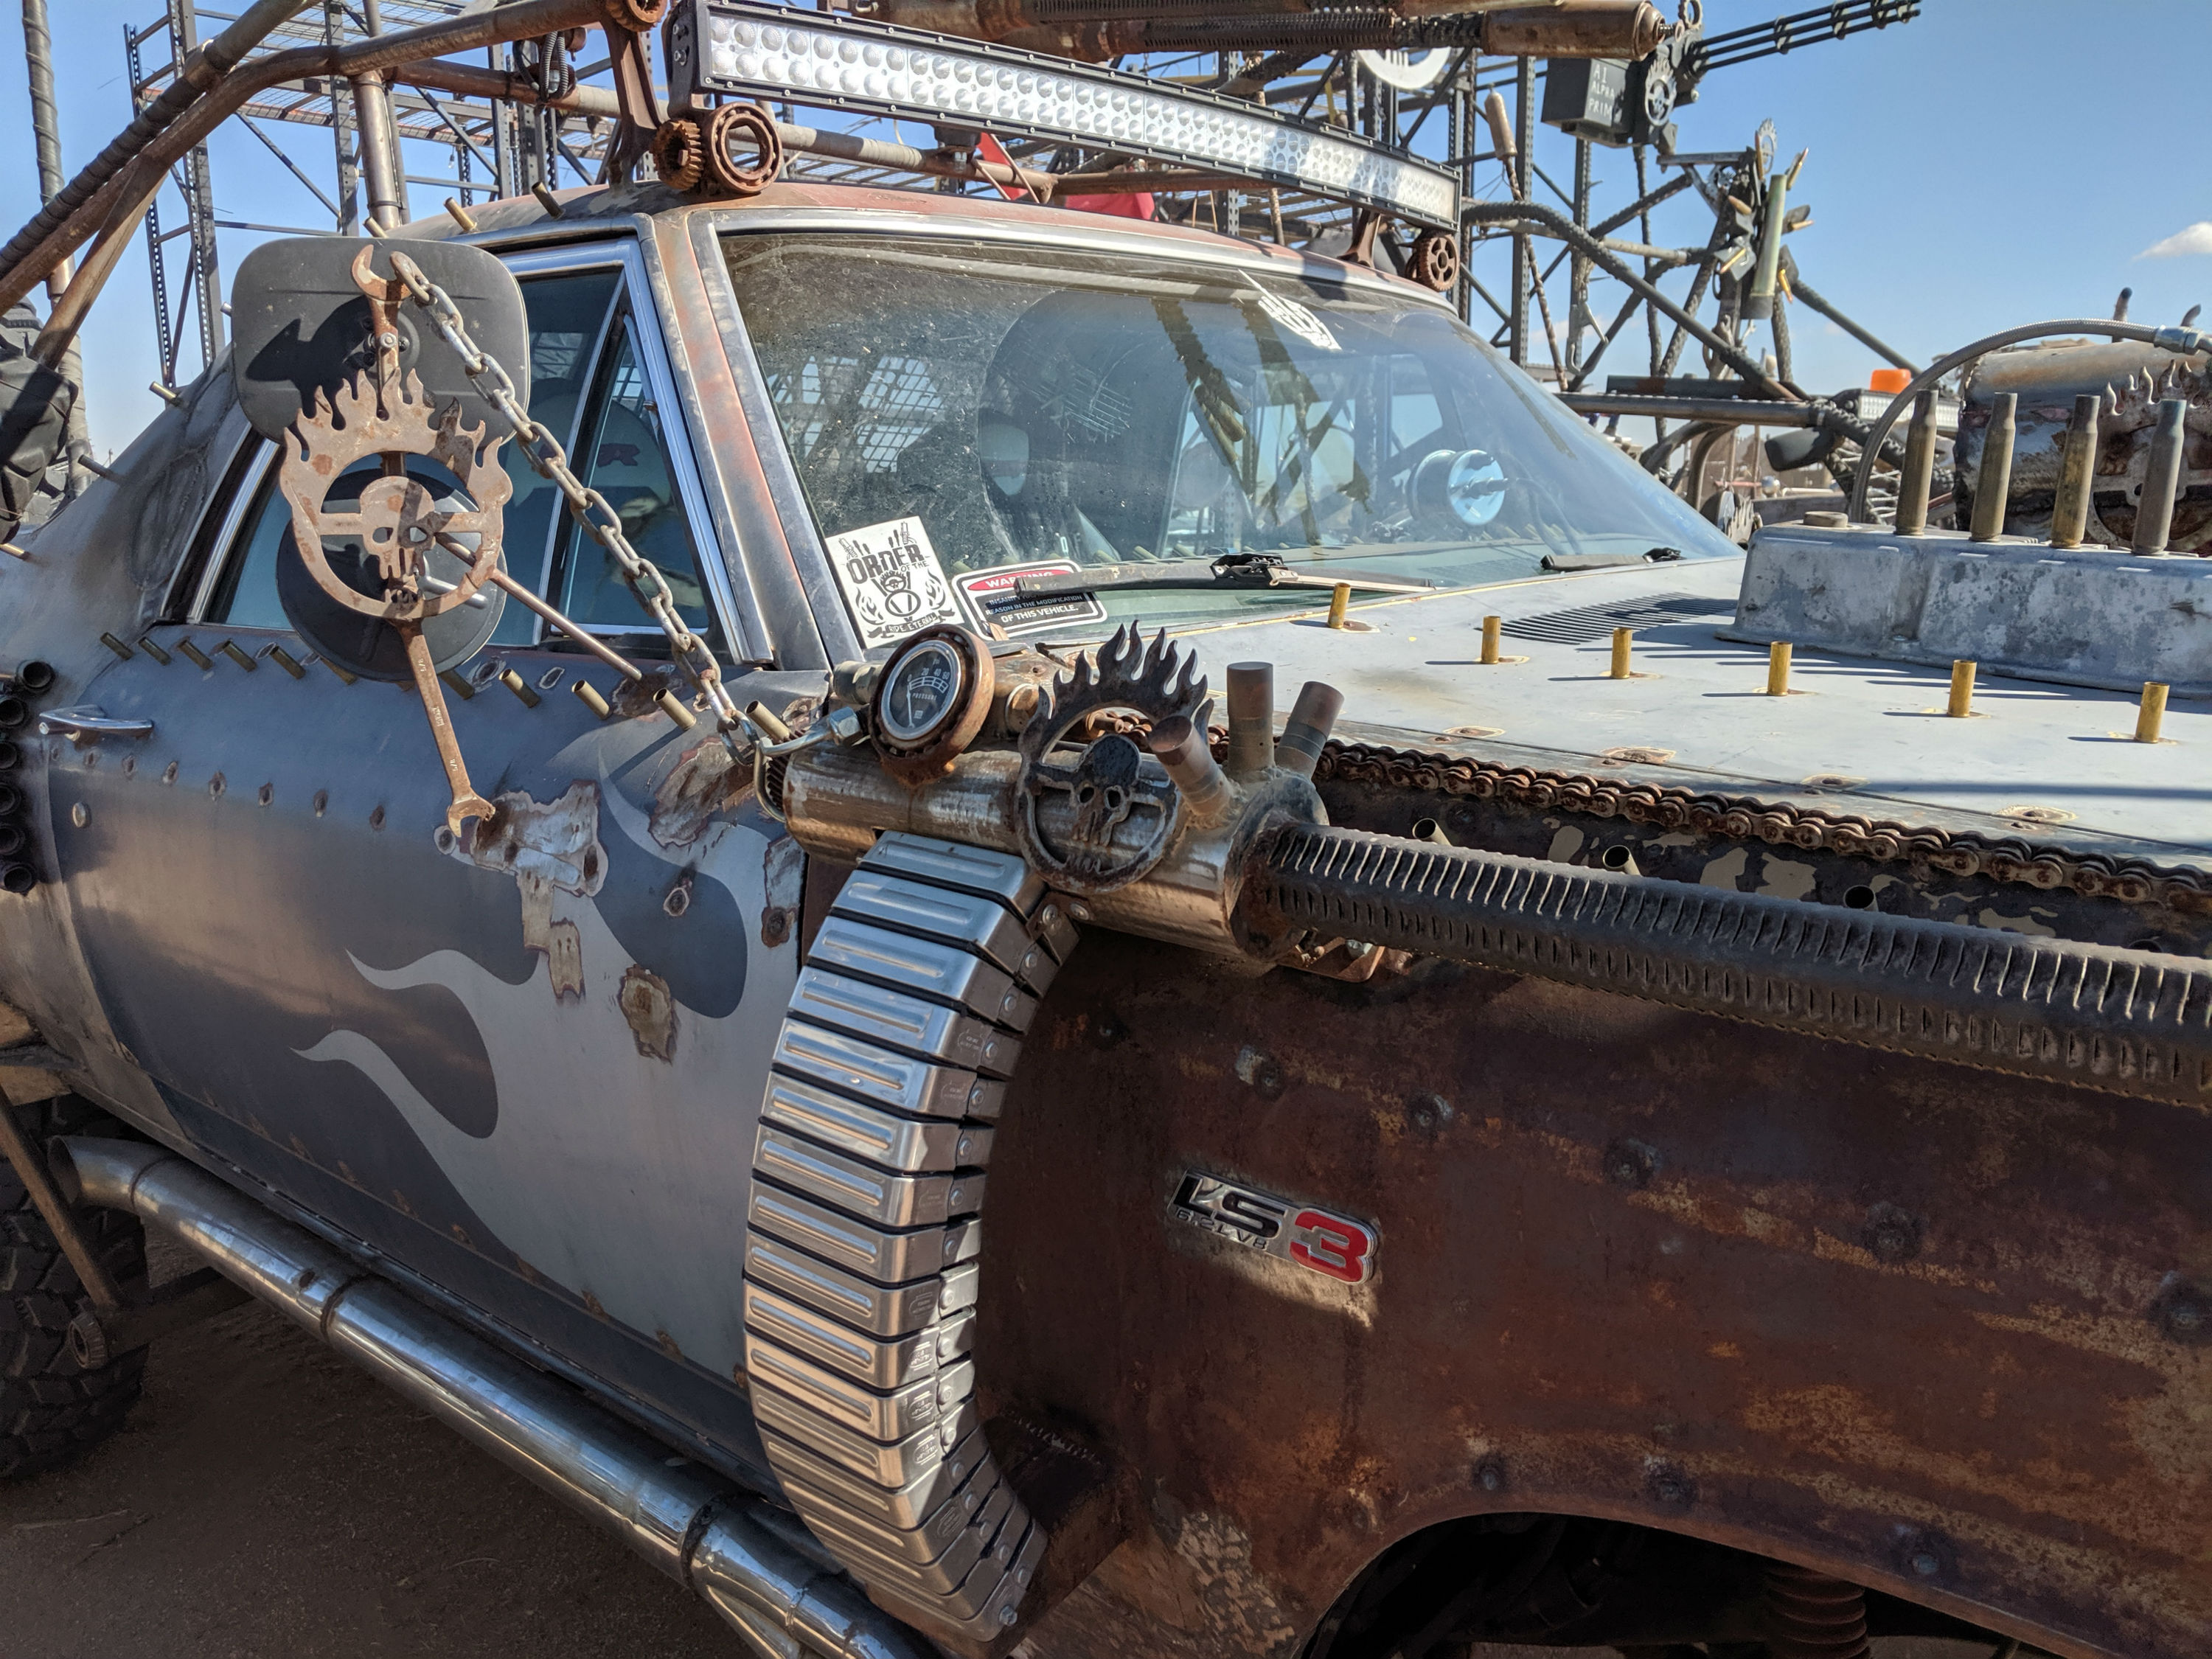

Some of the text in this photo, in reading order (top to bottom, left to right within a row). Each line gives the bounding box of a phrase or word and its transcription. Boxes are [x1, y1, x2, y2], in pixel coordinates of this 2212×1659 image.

[846, 543, 925, 584] ORDER
[900, 561, 930, 572] OF THE
[985, 604, 1015, 616] REASON
[1015, 603, 1023, 611] IN
[1022, 600, 1037, 609] THE
[1036, 595, 1083, 607] MODIFICATION
[1001, 604, 1079, 624] OF THIS VEHICLE.
[888, 613, 938, 633] RIDE ETERNAL
[907, 674, 912, 683] 0
[921, 667, 930, 676] 20
[933, 668, 942, 677] 40
[911, 692, 937, 701] PRESSURE
[1173, 1175, 1370, 1283] LS3
